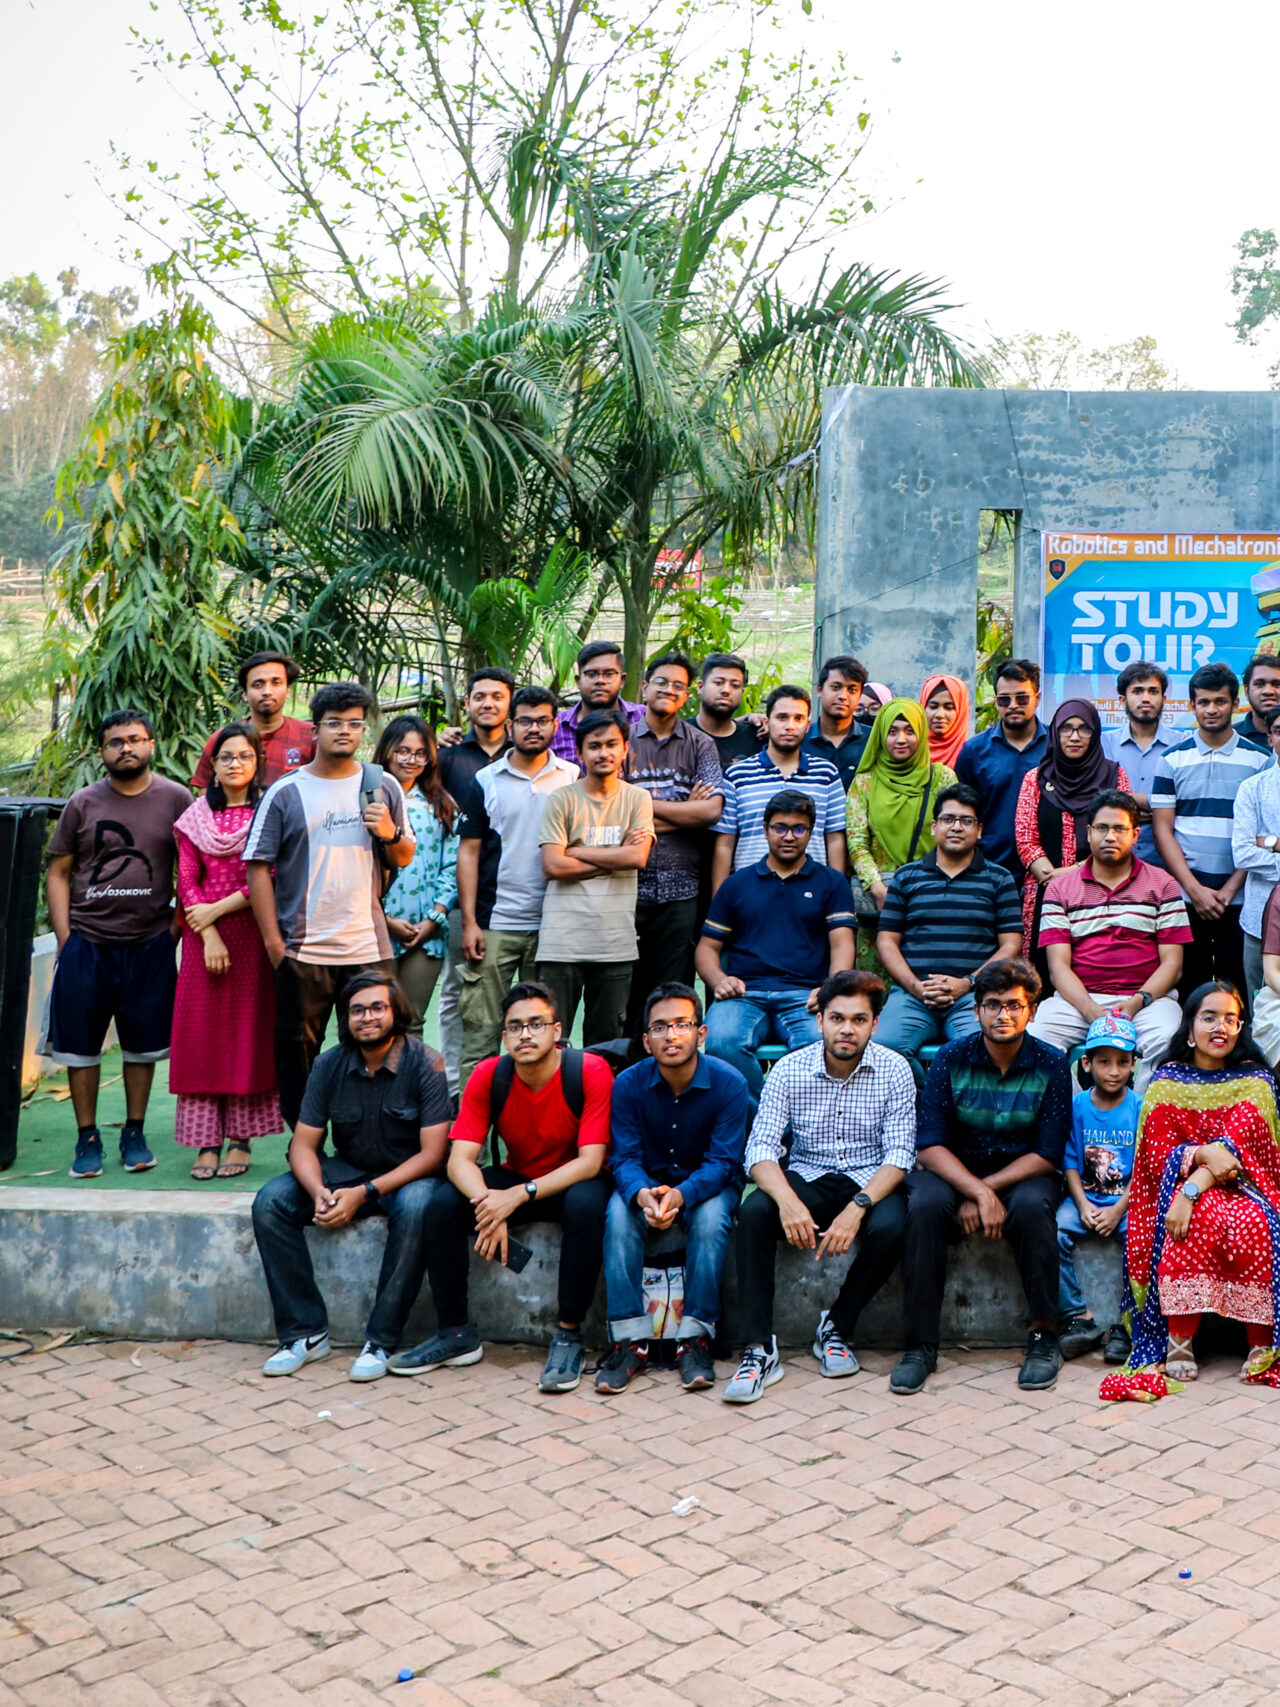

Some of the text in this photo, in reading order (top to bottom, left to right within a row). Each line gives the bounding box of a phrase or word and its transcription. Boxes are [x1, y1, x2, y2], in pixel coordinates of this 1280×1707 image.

[1048, 535, 1128, 555] Robotics
[1134, 535, 1168, 555] and
[1071, 591, 1239, 628] STUDY
[1071, 634, 1216, 671] TOUR
[1082, 1128, 1134, 1146] HAILAND
